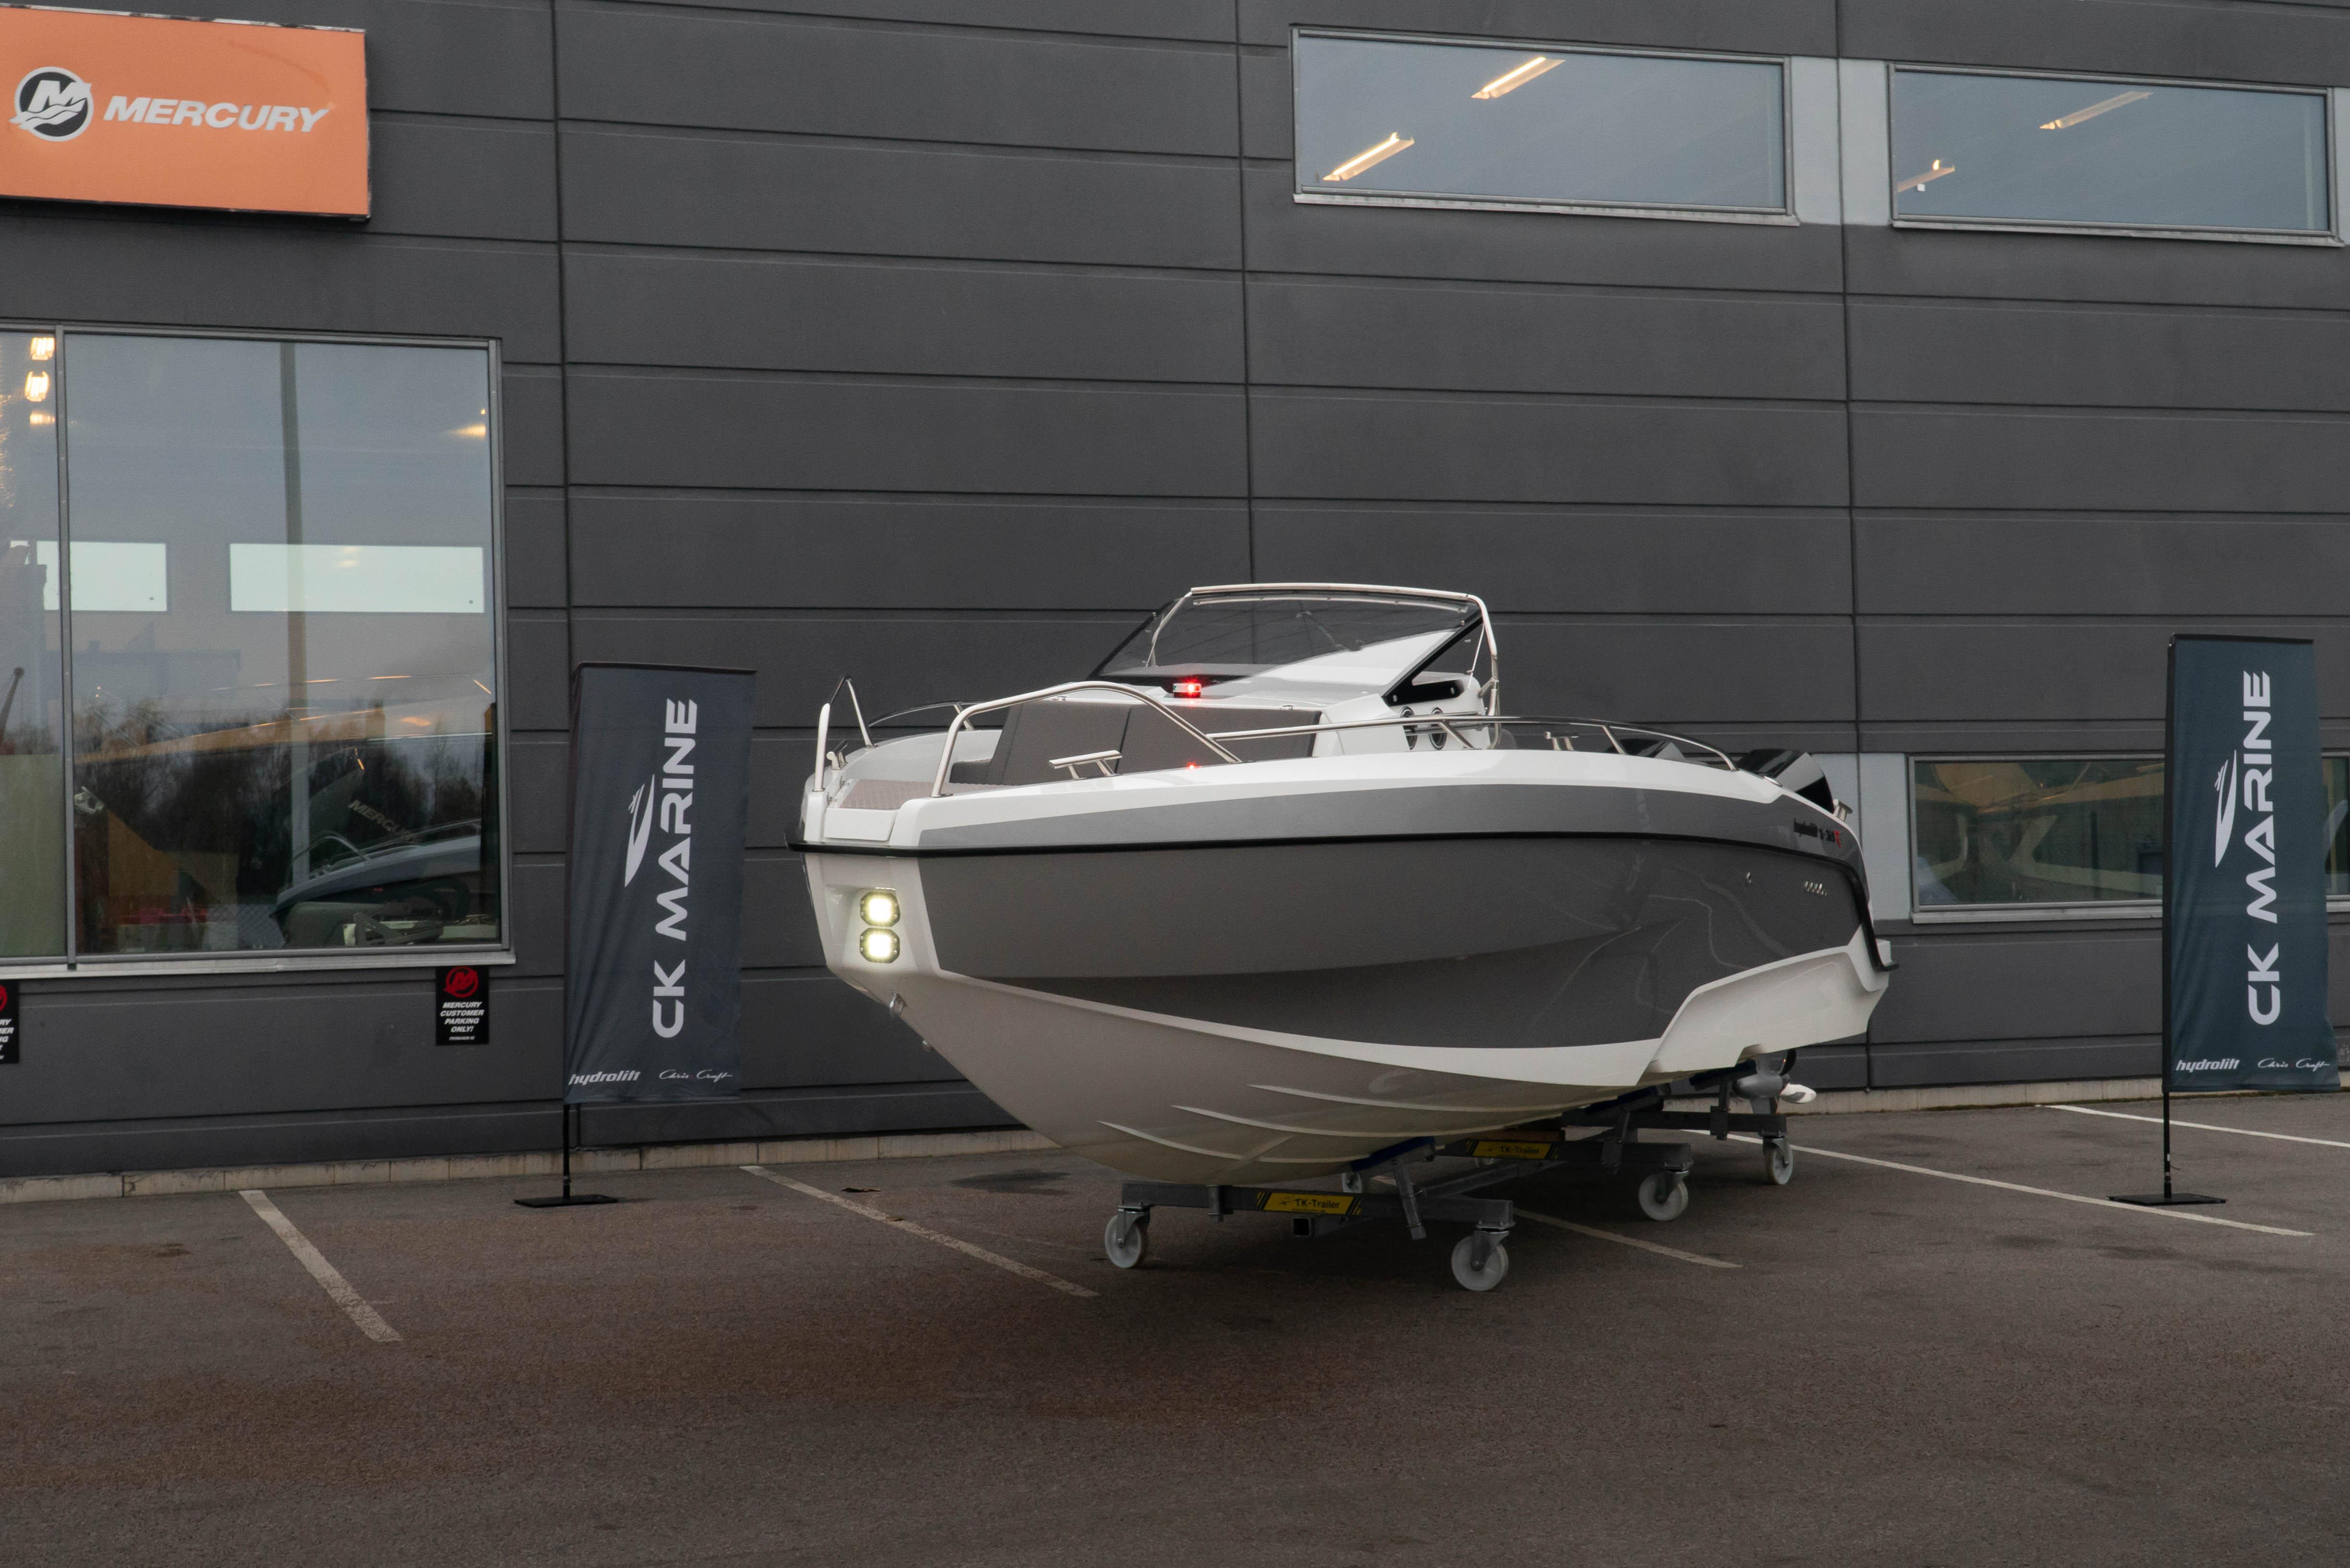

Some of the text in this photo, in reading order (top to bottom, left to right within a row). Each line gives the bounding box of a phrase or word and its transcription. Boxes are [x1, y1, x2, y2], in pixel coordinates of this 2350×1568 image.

[104, 96, 331, 132] MERCURY
[2243, 670, 2280, 1025] CK MARINE
[653, 698, 698, 1038] CK MARINE
[568, 1069, 733, 1086] hydrolift Chris Craft
[2175, 1058, 2330, 1073] hydrolift Chris Craft
[1295, 1199, 1340, 1208] TK-Trailer
